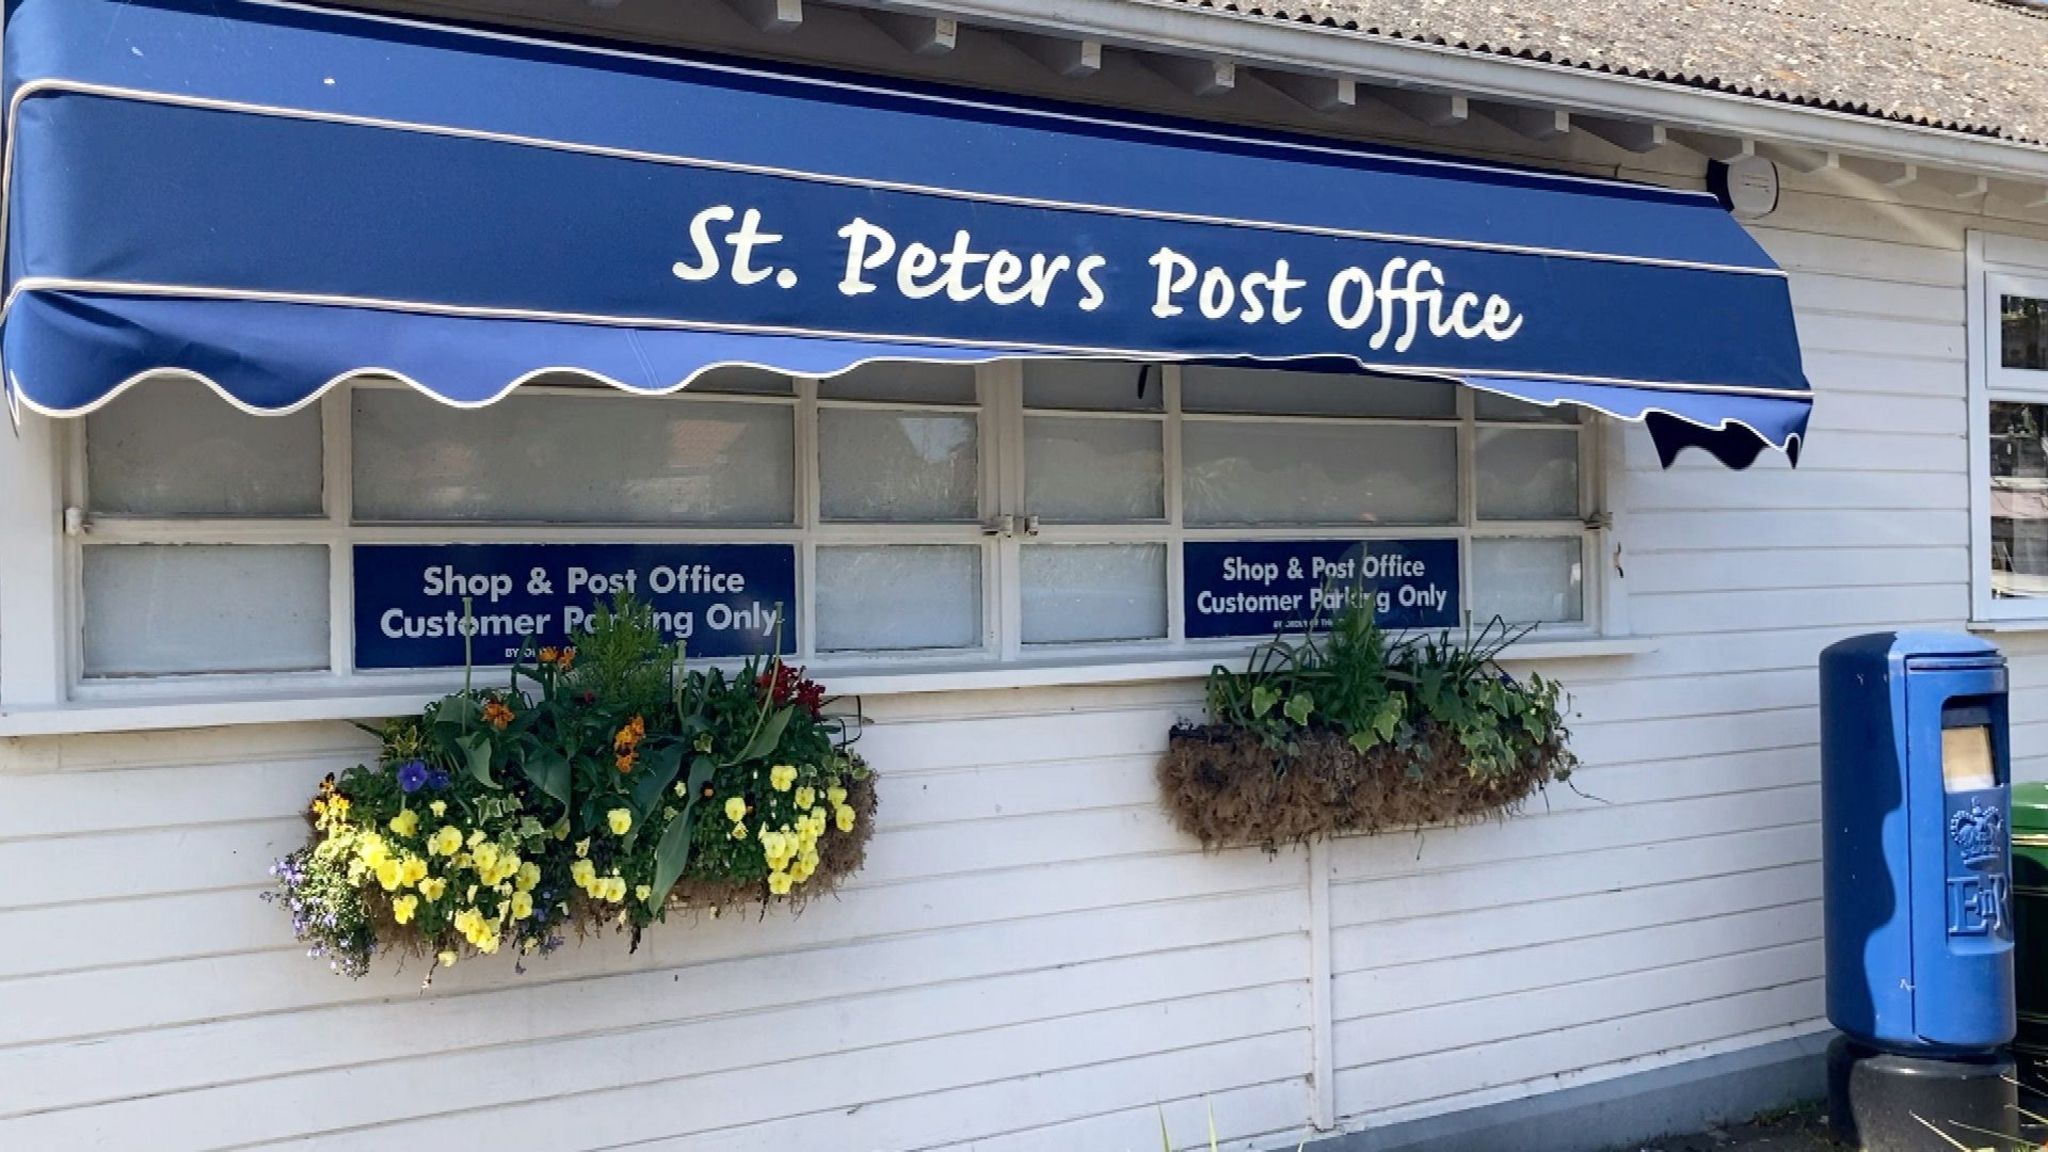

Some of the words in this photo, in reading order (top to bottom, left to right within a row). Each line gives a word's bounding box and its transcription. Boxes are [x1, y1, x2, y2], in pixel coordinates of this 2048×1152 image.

[672, 204, 798, 289] St.
[837, 217, 1106, 312] Peters
[1148, 246, 1307, 325] Post
[1327, 256, 1523, 353] Office
[422, 566, 512, 603] Shop
[526, 567, 553, 595] &
[568, 566, 638, 594] Post
[649, 564, 745, 594] Office
[1223, 556, 1279, 586] Shop
[1287, 557, 1304, 579] &
[1312, 556, 1355, 579] Post
[1361, 554, 1425, 577] Office
[1197, 590, 1303, 614] Customer
[1398, 583, 1447, 611] Only
[380, 606, 551, 639] Customer
[705, 601, 780, 637] Only
